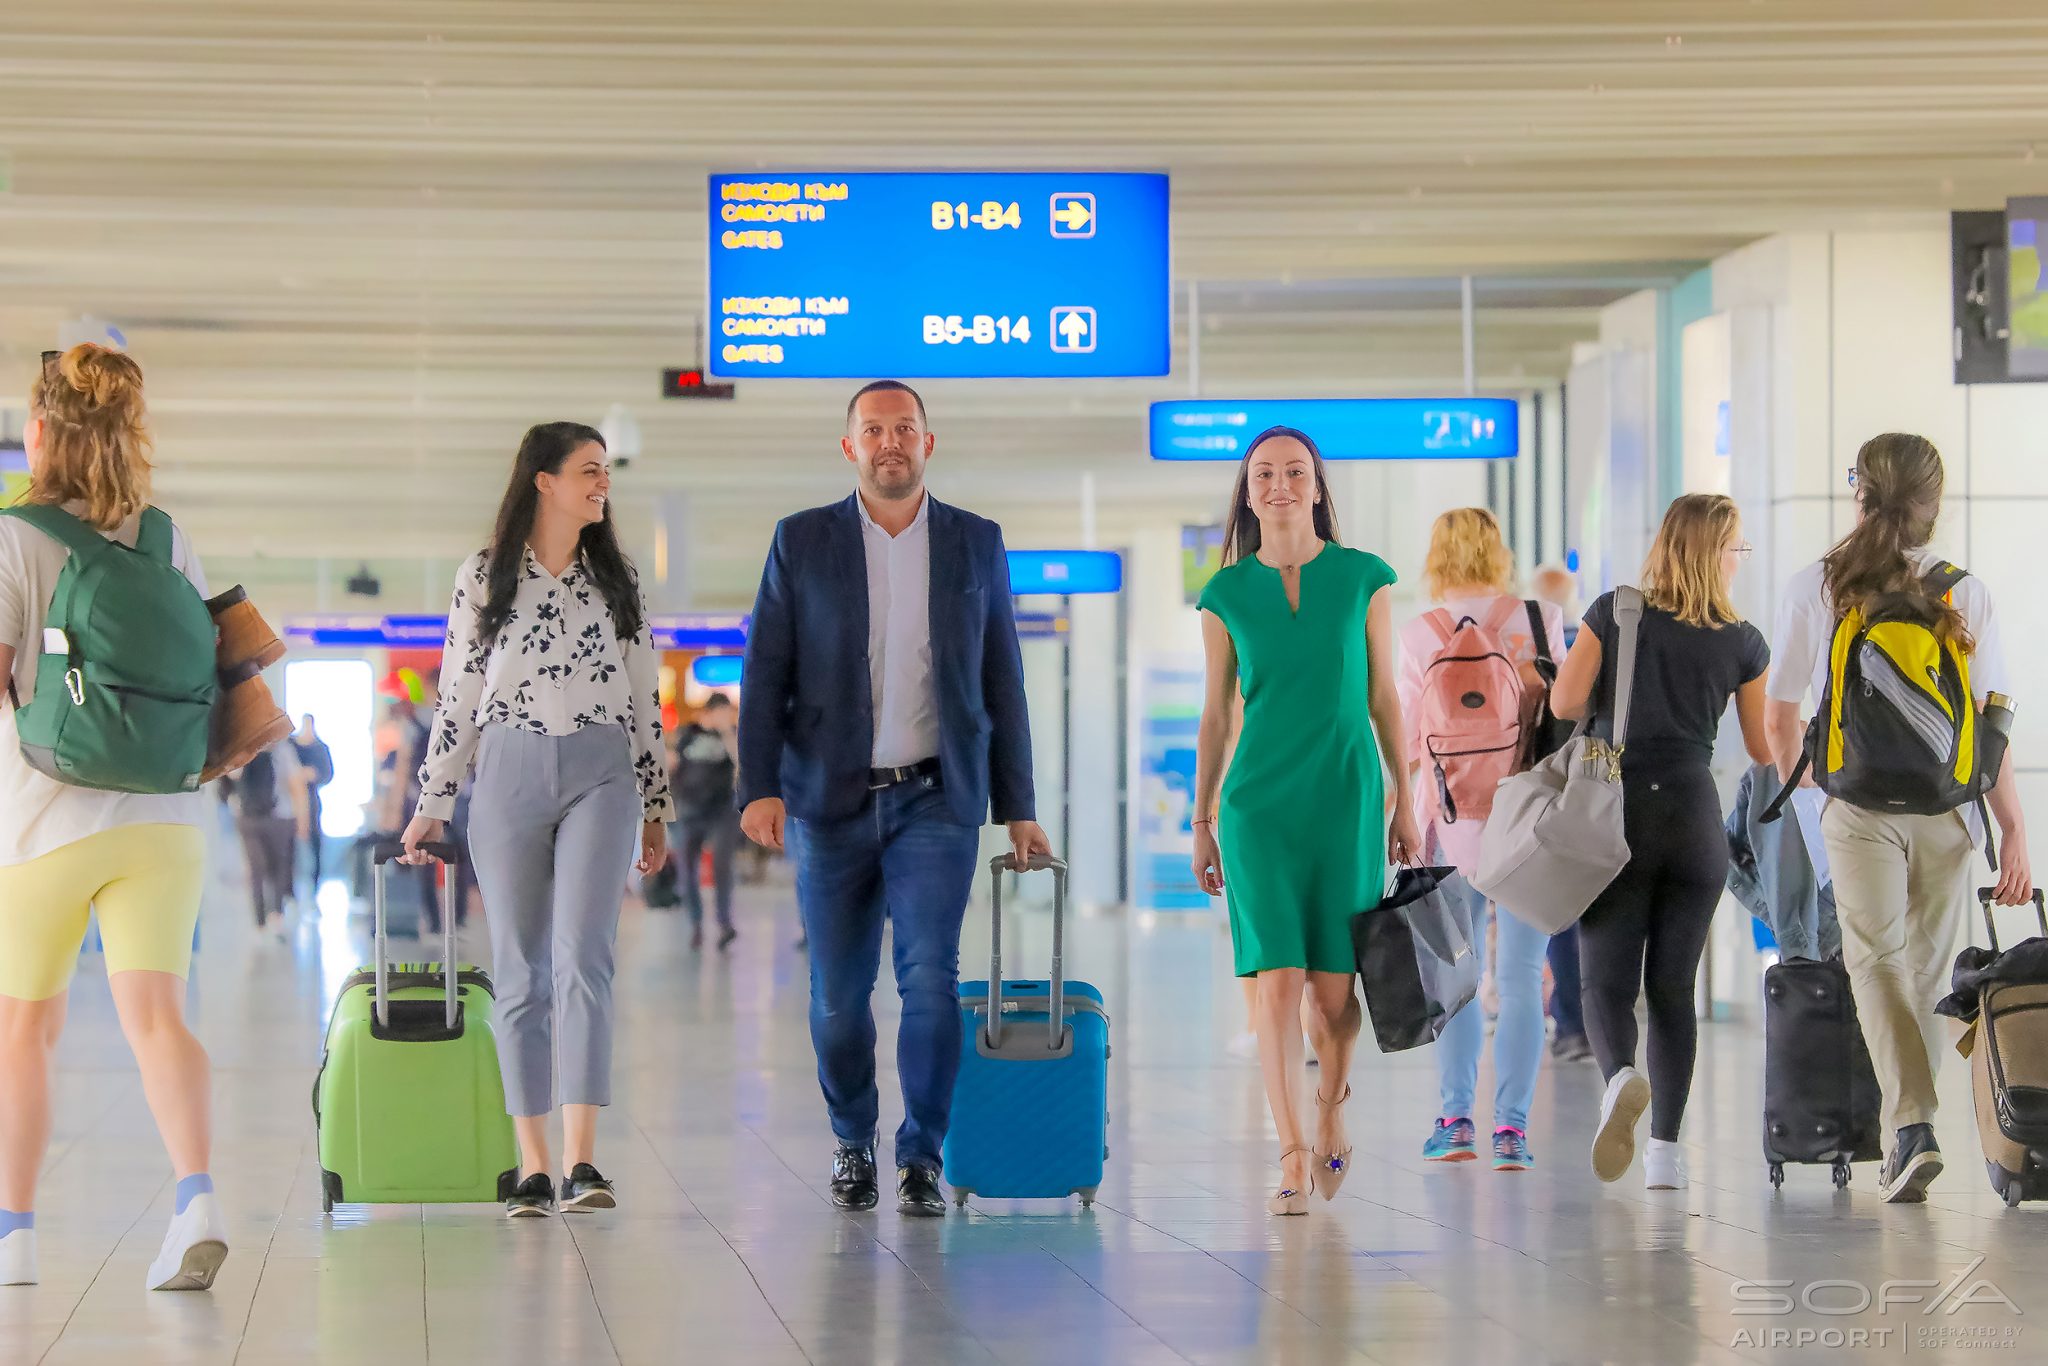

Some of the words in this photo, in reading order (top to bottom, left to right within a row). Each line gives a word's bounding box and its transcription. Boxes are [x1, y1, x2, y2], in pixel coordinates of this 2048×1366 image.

[932, 201, 1022, 230] B1-B4
[721, 230, 784, 250] GATES
[923, 315, 1031, 344] B5-B14
[722, 344, 785, 363] GATES
